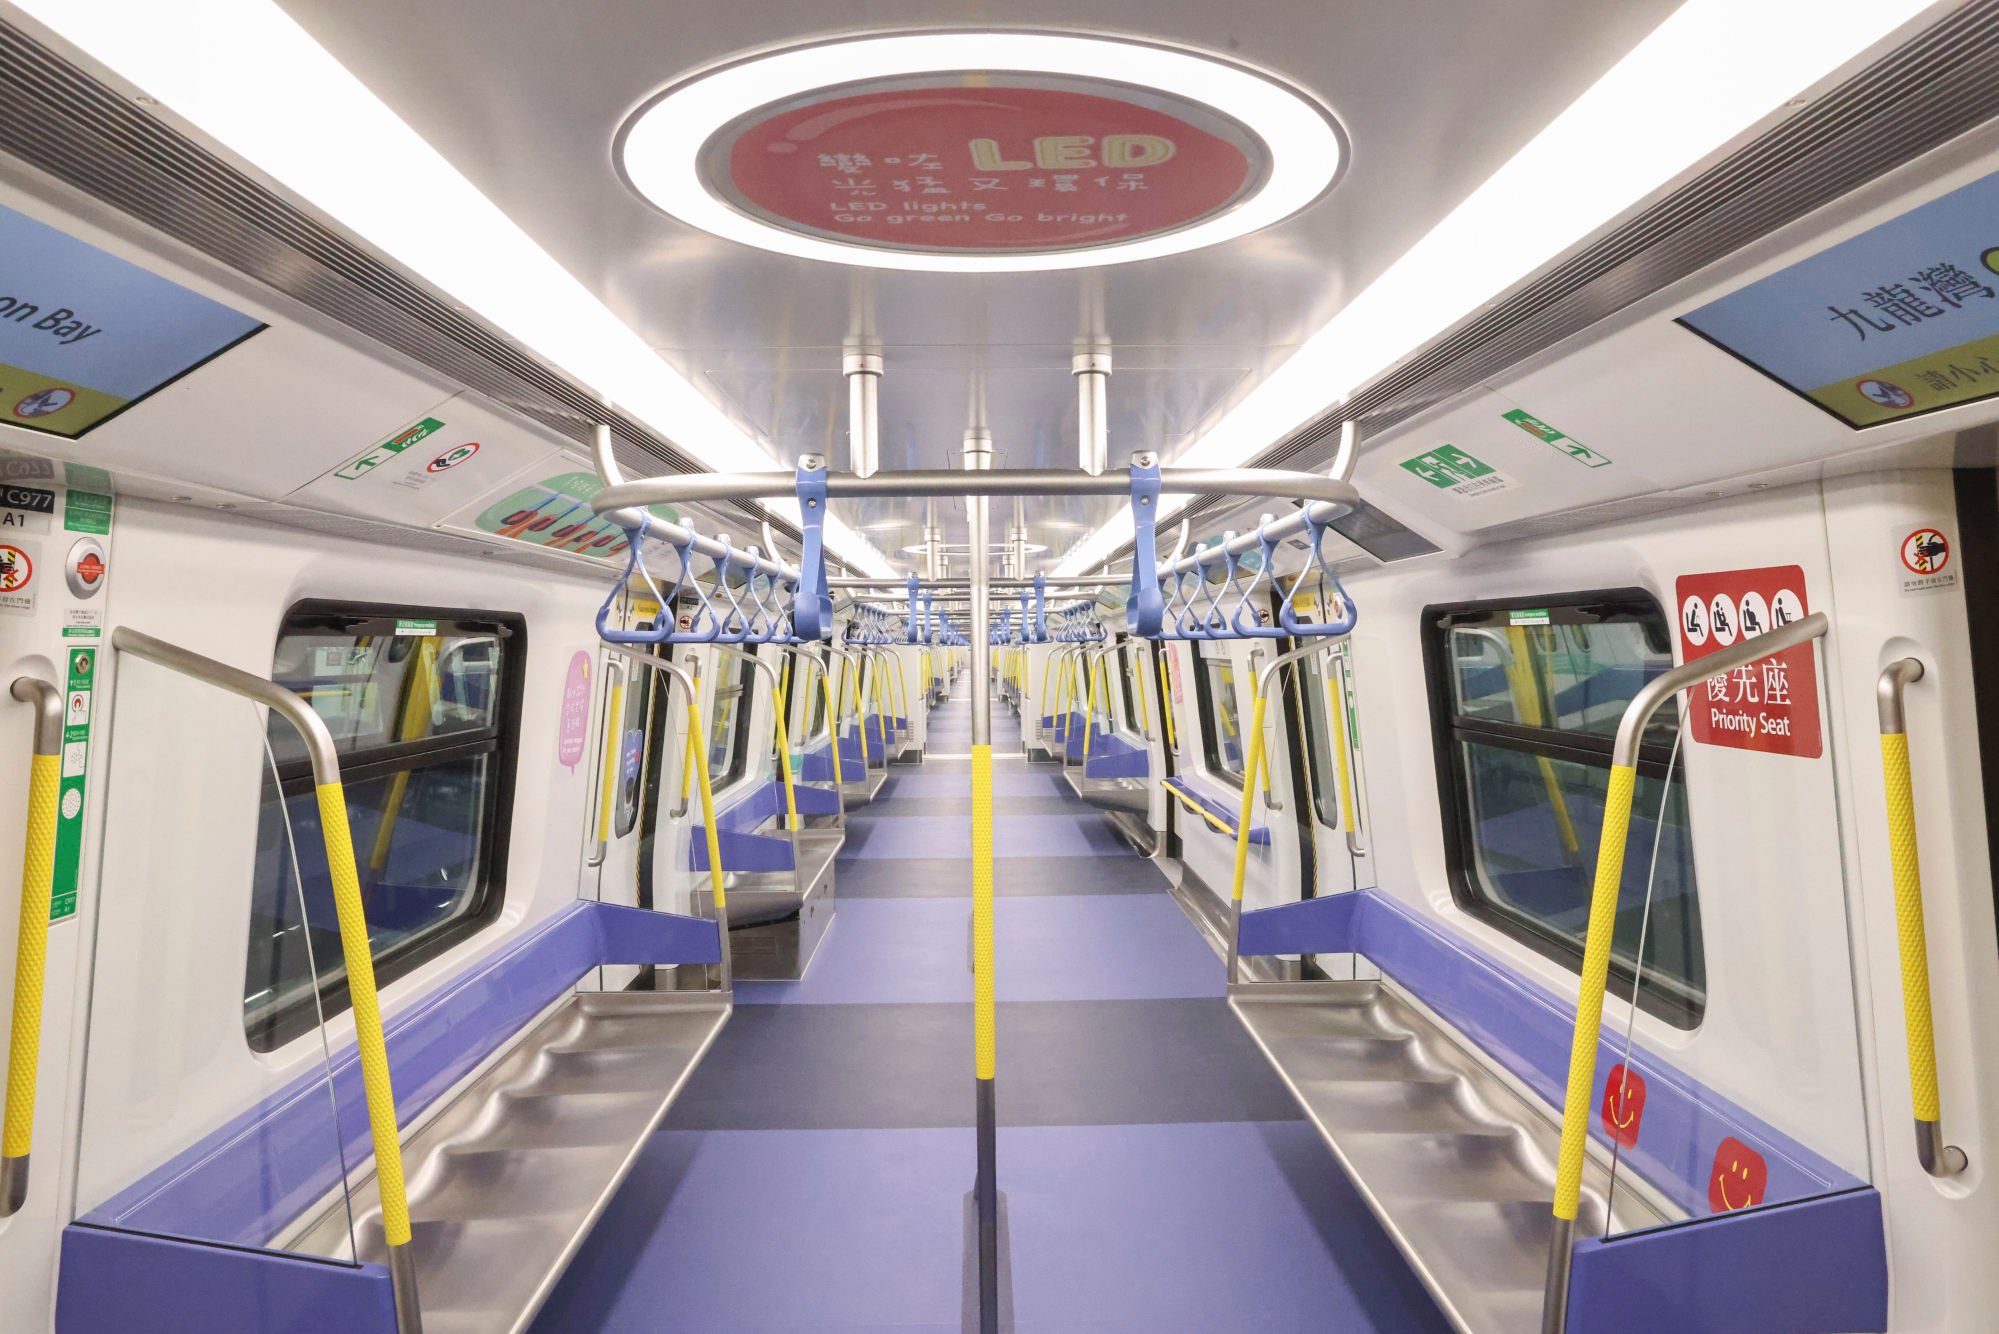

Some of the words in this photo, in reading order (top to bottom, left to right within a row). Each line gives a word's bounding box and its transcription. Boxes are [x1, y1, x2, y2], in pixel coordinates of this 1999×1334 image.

[967, 134, 1176, 172] LED
[830, 201, 888, 211] LED
[903, 200, 988, 213] lights
[833, 213, 873, 223] Go
[887, 214, 970, 225] green
[985, 213, 1024, 223] Go
[1037, 212, 1130, 225] bright
[1827, 262, 1996, 341] 九龍灣
[32, 308, 102, 345] Bay
[7, 489, 52, 508] C977
[1711, 707, 1757, 738] Priority
[1760, 712, 1791, 736] Seat
